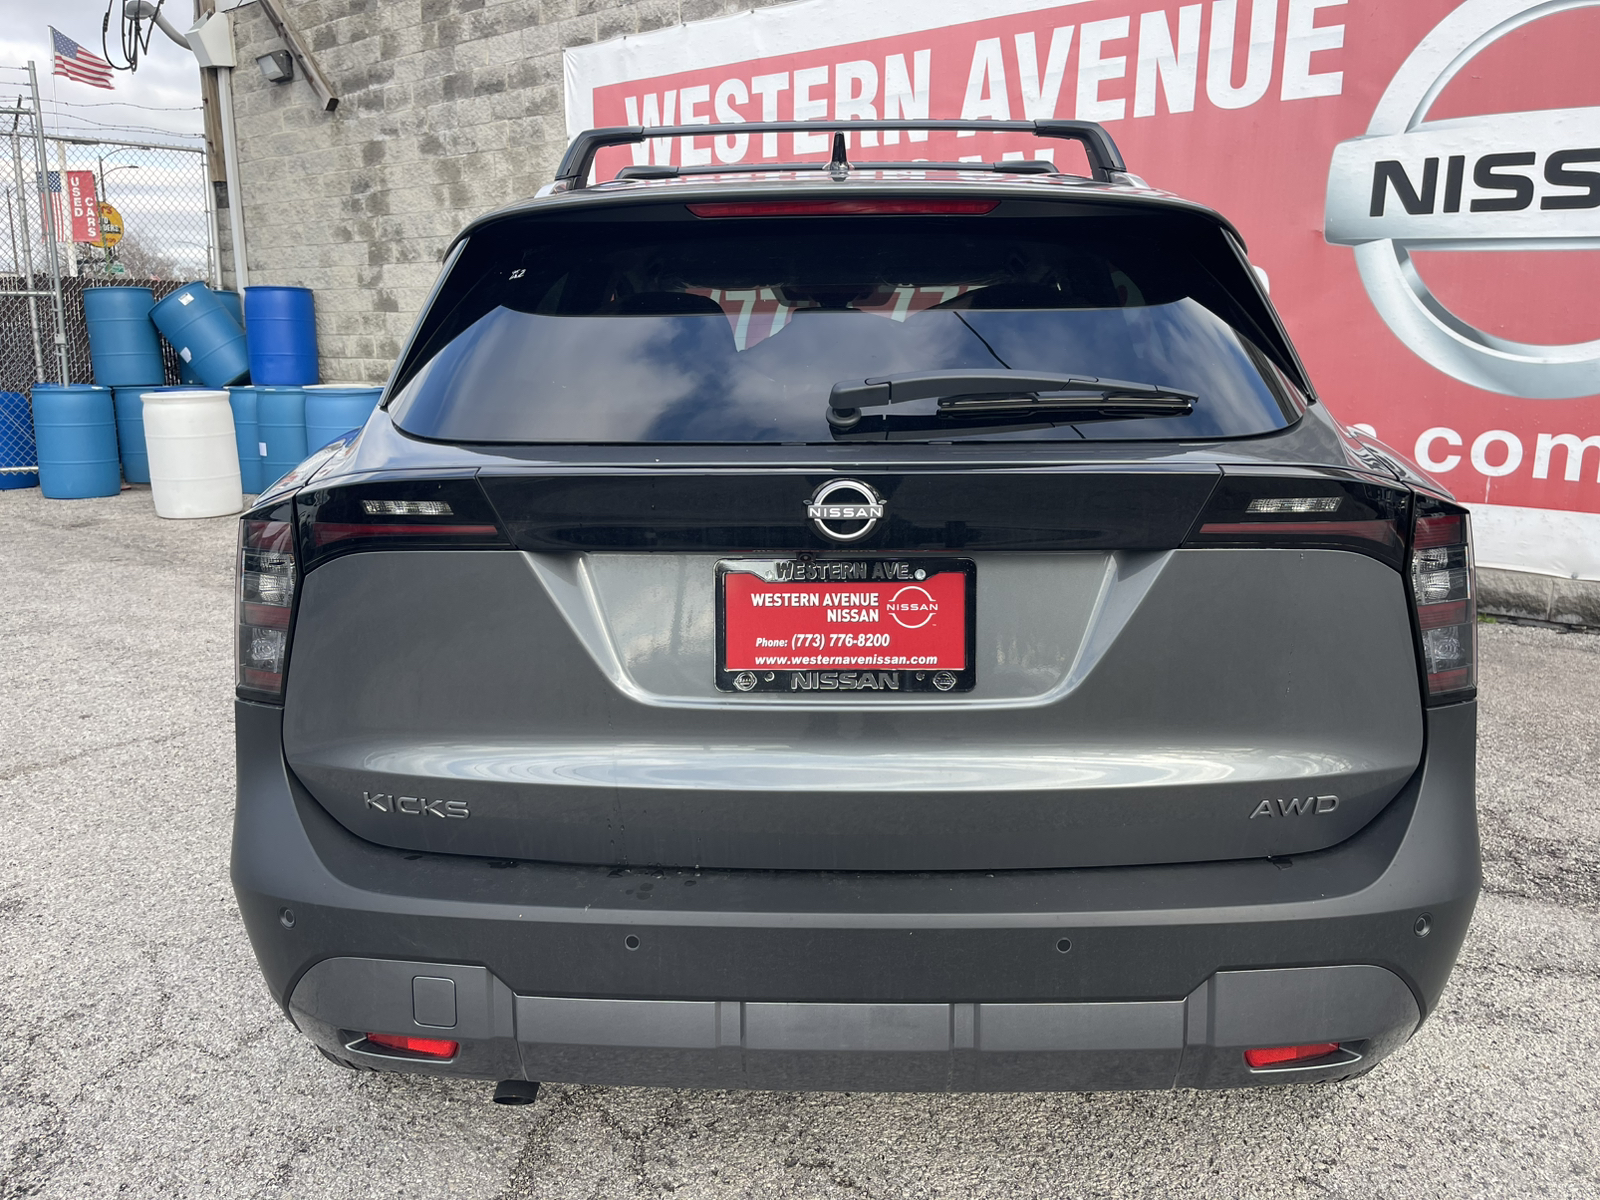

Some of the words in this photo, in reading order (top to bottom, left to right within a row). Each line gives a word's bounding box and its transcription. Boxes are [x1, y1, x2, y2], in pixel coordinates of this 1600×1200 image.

[624, 49, 931, 167] WESTERN
[956, 0, 1350, 138] AVENUE
[71, 177, 84, 217] USED
[85, 197, 97, 237] CARS
[809, 507, 881, 518] NISSAN
[775, 560, 867, 580] WESTERN
[872, 561, 914, 580] AVE.
[751, 592, 819, 607] WESTERN
[822, 592, 879, 607] AVENUE
[886, 603, 938, 611] NISSAN
[827, 609, 879, 622] NISSAN
[755, 637, 788, 647] Phone:
[791, 633, 825, 650] (773)
[829, 633, 890, 647] 776-8200
[755, 654, 938, 665] www.westernavenissan.com
[790, 672, 900, 690] NISSAN
[363, 791, 471, 819] KICKS
[1249, 794, 1340, 819] AWD
